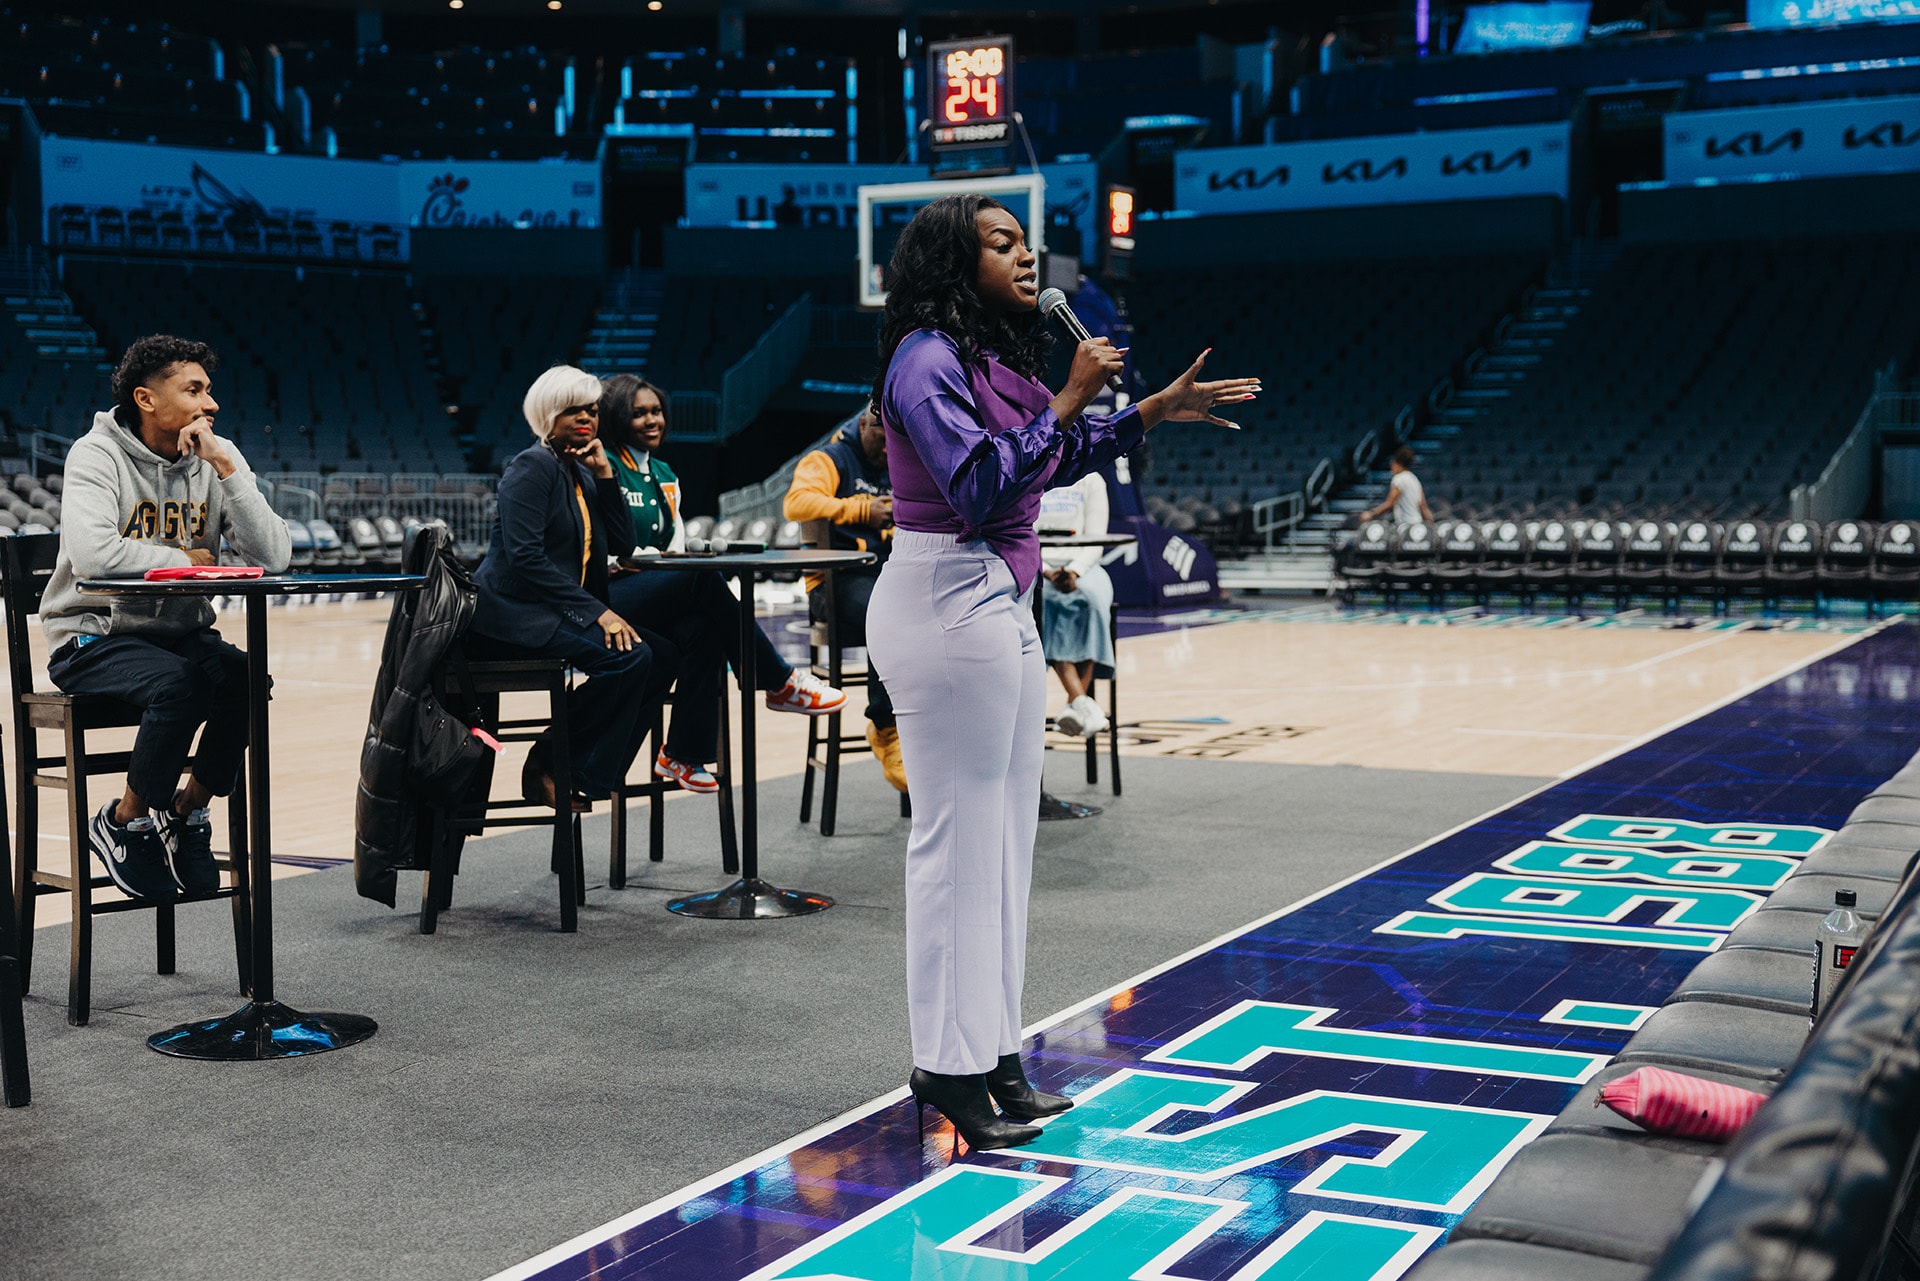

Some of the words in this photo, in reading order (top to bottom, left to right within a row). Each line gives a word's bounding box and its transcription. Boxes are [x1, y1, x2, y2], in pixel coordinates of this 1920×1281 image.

[945, 77, 997, 122] 24
[121, 499, 208, 541] AGGES
[1372, 813, 1836, 952] 1988
